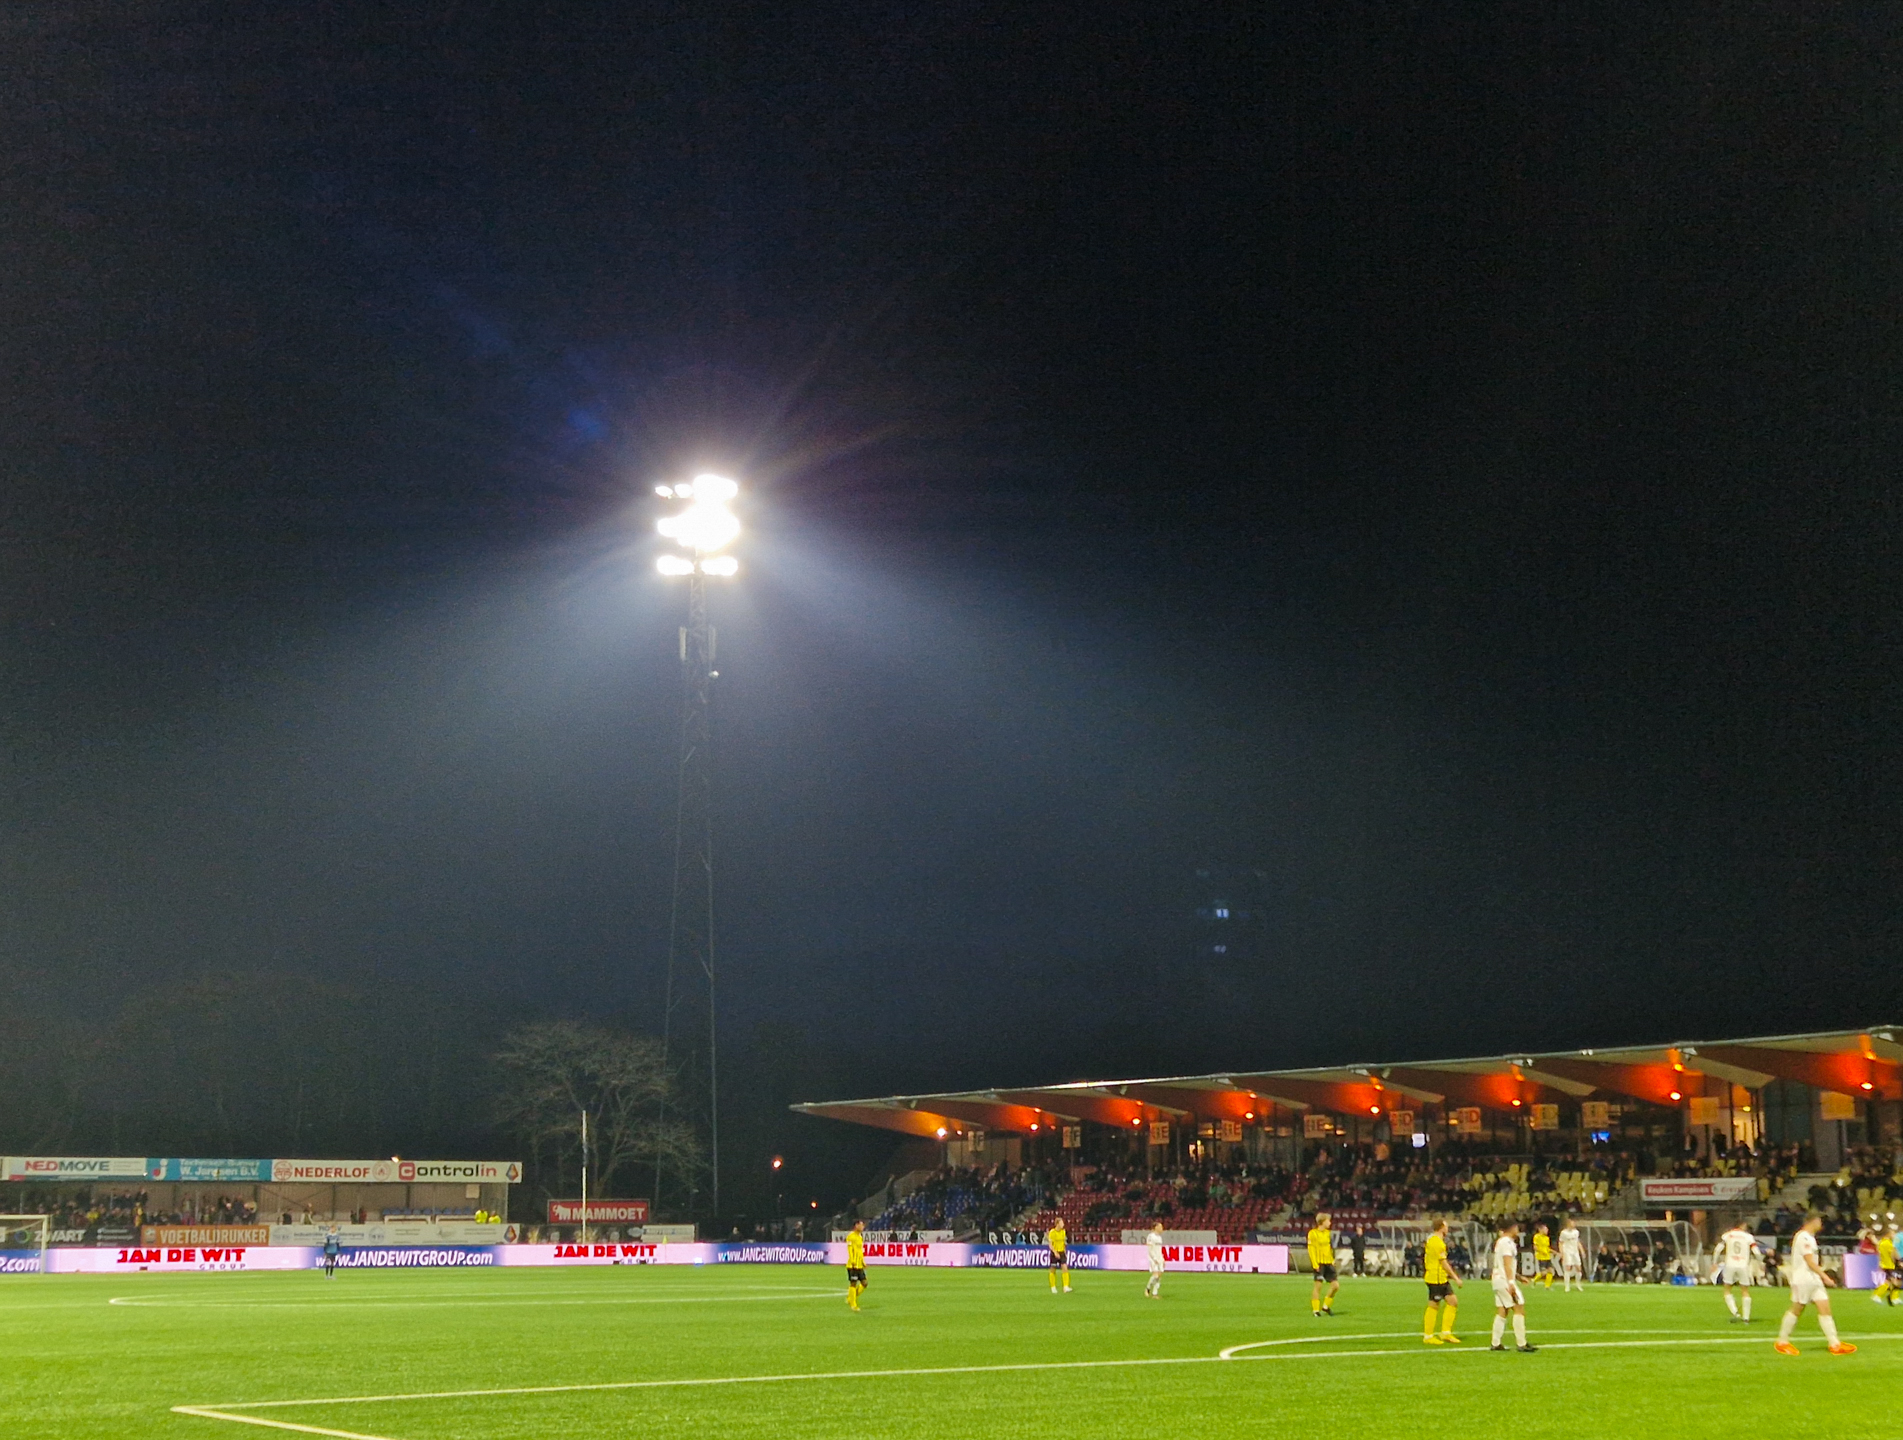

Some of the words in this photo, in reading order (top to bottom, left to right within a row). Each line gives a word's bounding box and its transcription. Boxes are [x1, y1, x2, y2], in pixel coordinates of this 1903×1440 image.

[25, 1160, 110, 1171] NEDMOVE
[294, 1167, 371, 1178] NEDERLOF
[572, 1207, 645, 1220] MAMMOET
[160, 1230, 267, 1244] VOETBALDRUKKER
[554, 1245, 590, 1258] JAN
[593, 1246, 617, 1257] DE
[620, 1245, 657, 1257] WIT
[888, 1244, 904, 1257] DE
[906, 1244, 930, 1258] WIT
[1161, 1246, 1180, 1262] AN
[1184, 1247, 1203, 1262] DE
[1206, 1247, 1243, 1262] WIT
[1733, 1241, 1742, 1255] 6
[117, 1249, 161, 1263] JAN
[167, 1250, 195, 1263] DE
[201, 1249, 246, 1262] WIT
[315, 1250, 493, 1268] ww.JANDEWITGROUP.com
